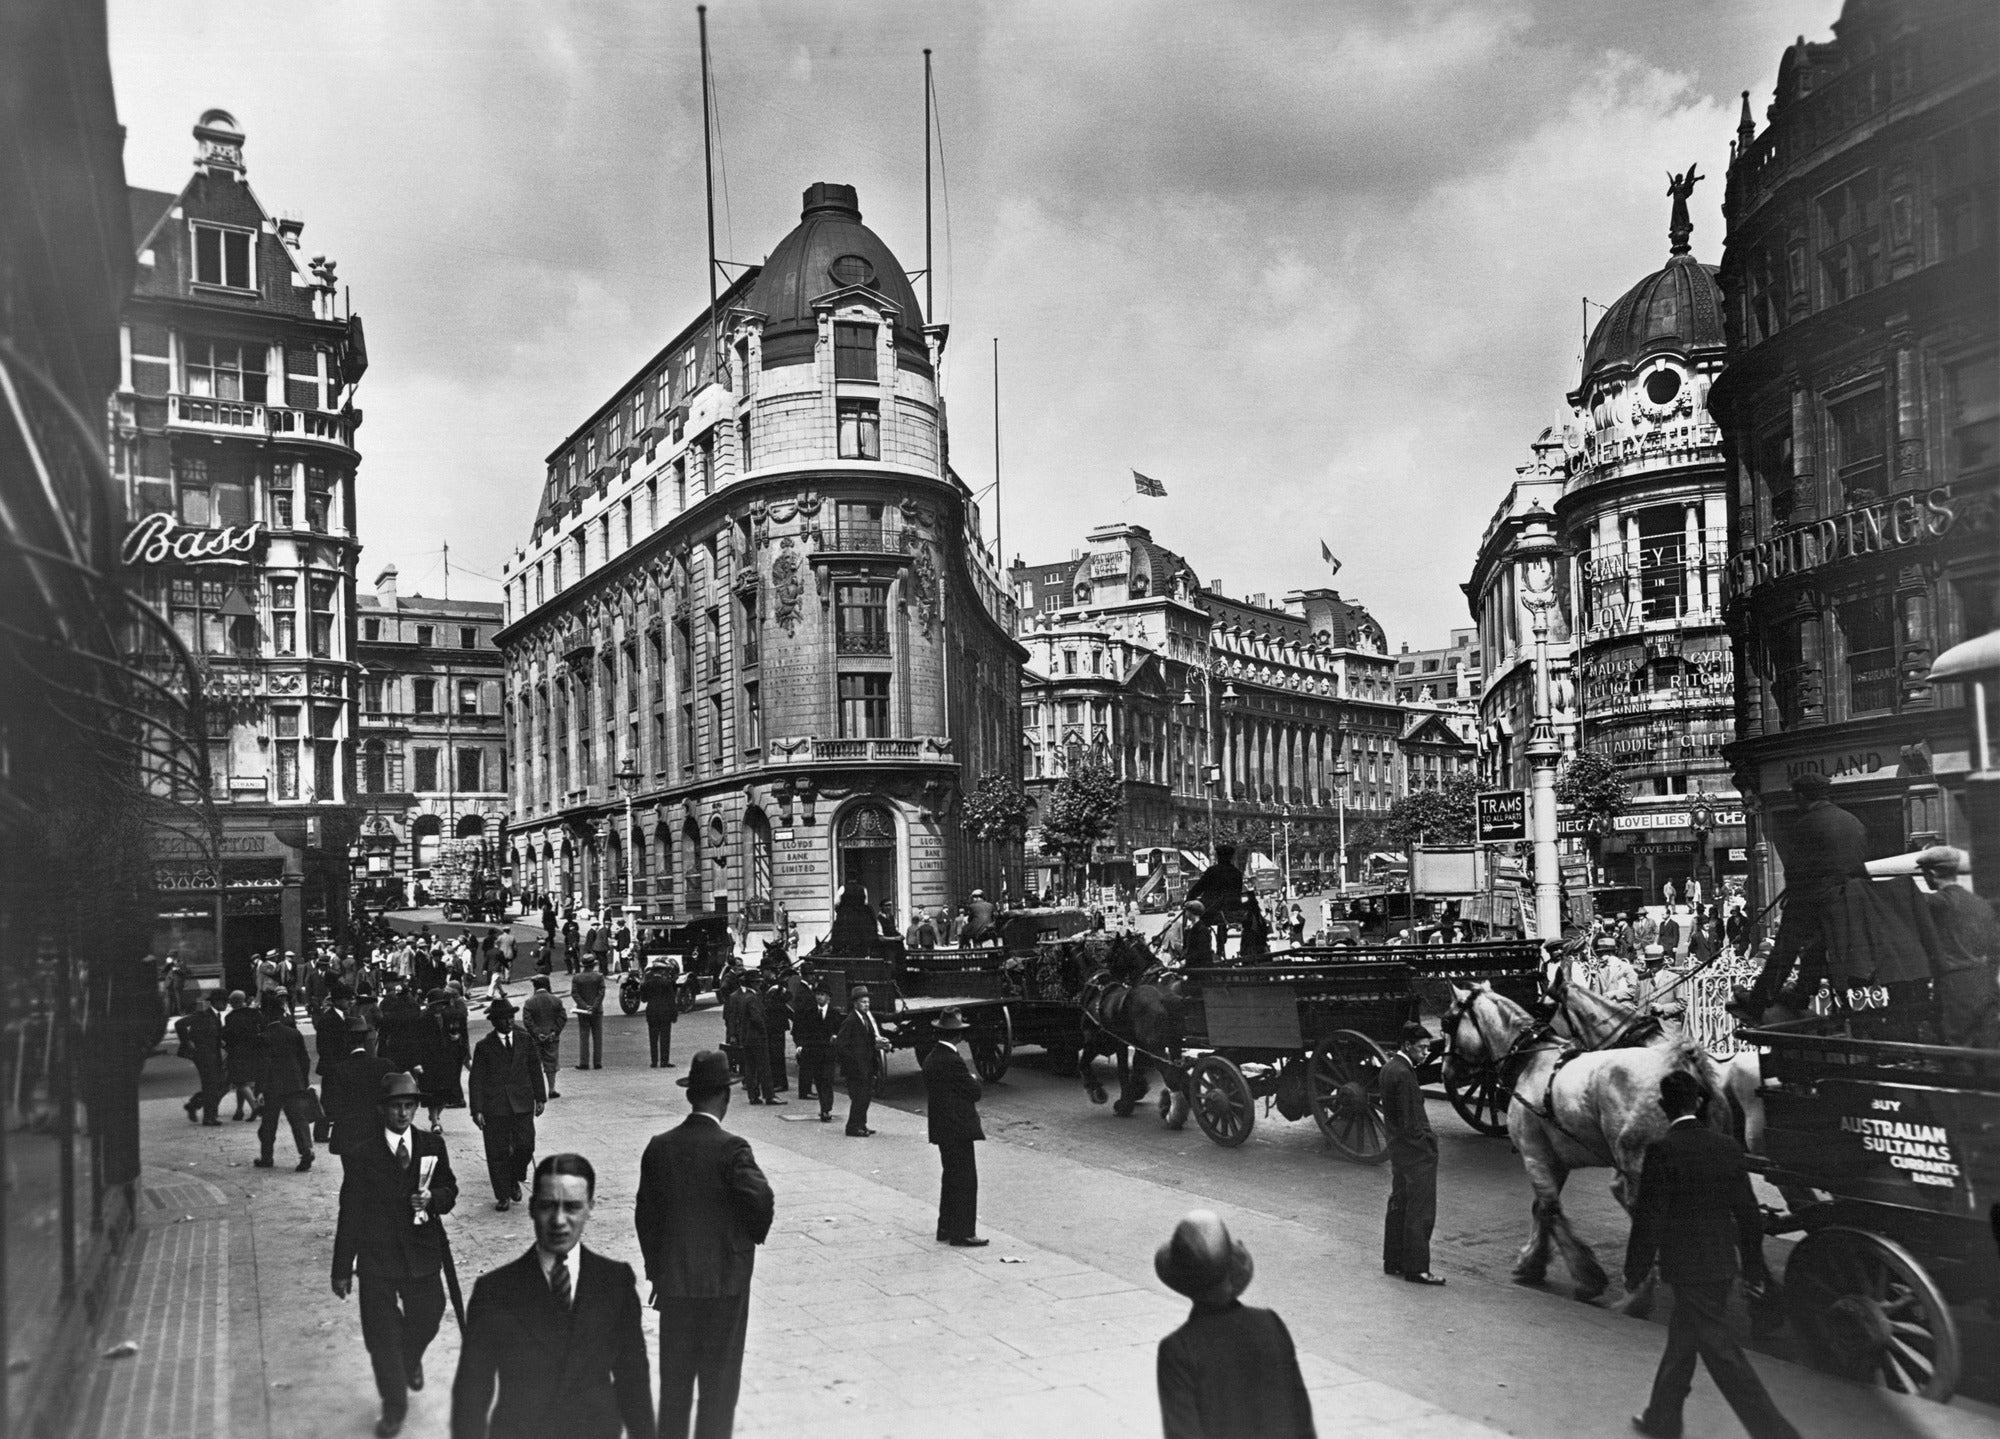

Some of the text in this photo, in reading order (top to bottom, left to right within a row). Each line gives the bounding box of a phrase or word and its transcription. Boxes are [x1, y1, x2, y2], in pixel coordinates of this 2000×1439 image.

[121, 512, 261, 565] Bass
[1755, 486, 1954, 586] BUILDINGS
[1584, 547, 1664, 581] STANLEY
[1654, 578, 1665, 587] IN
[1584, 598, 1656, 636] LOVE
[1589, 659, 1638, 678] MADGE
[1587, 678, 1644, 698] ELLIOTT
[1604, 737, 1657, 754] LADDIE
[1481, 797, 1522, 814] TRAMS
[1482, 812, 1523, 823] TO ALL PARTS
[782, 840, 813, 850] LLOYDS
[787, 852, 809, 861] BANK
[781, 864, 816, 874] LIMITED
[1871, 1099, 1902, 1112] BUY
[1840, 1116, 1947, 1144] AUSTRALIAN
[1863, 1136, 1951, 1161] SULTANAS
[1890, 1155, 1960, 1176] CURRANTS
